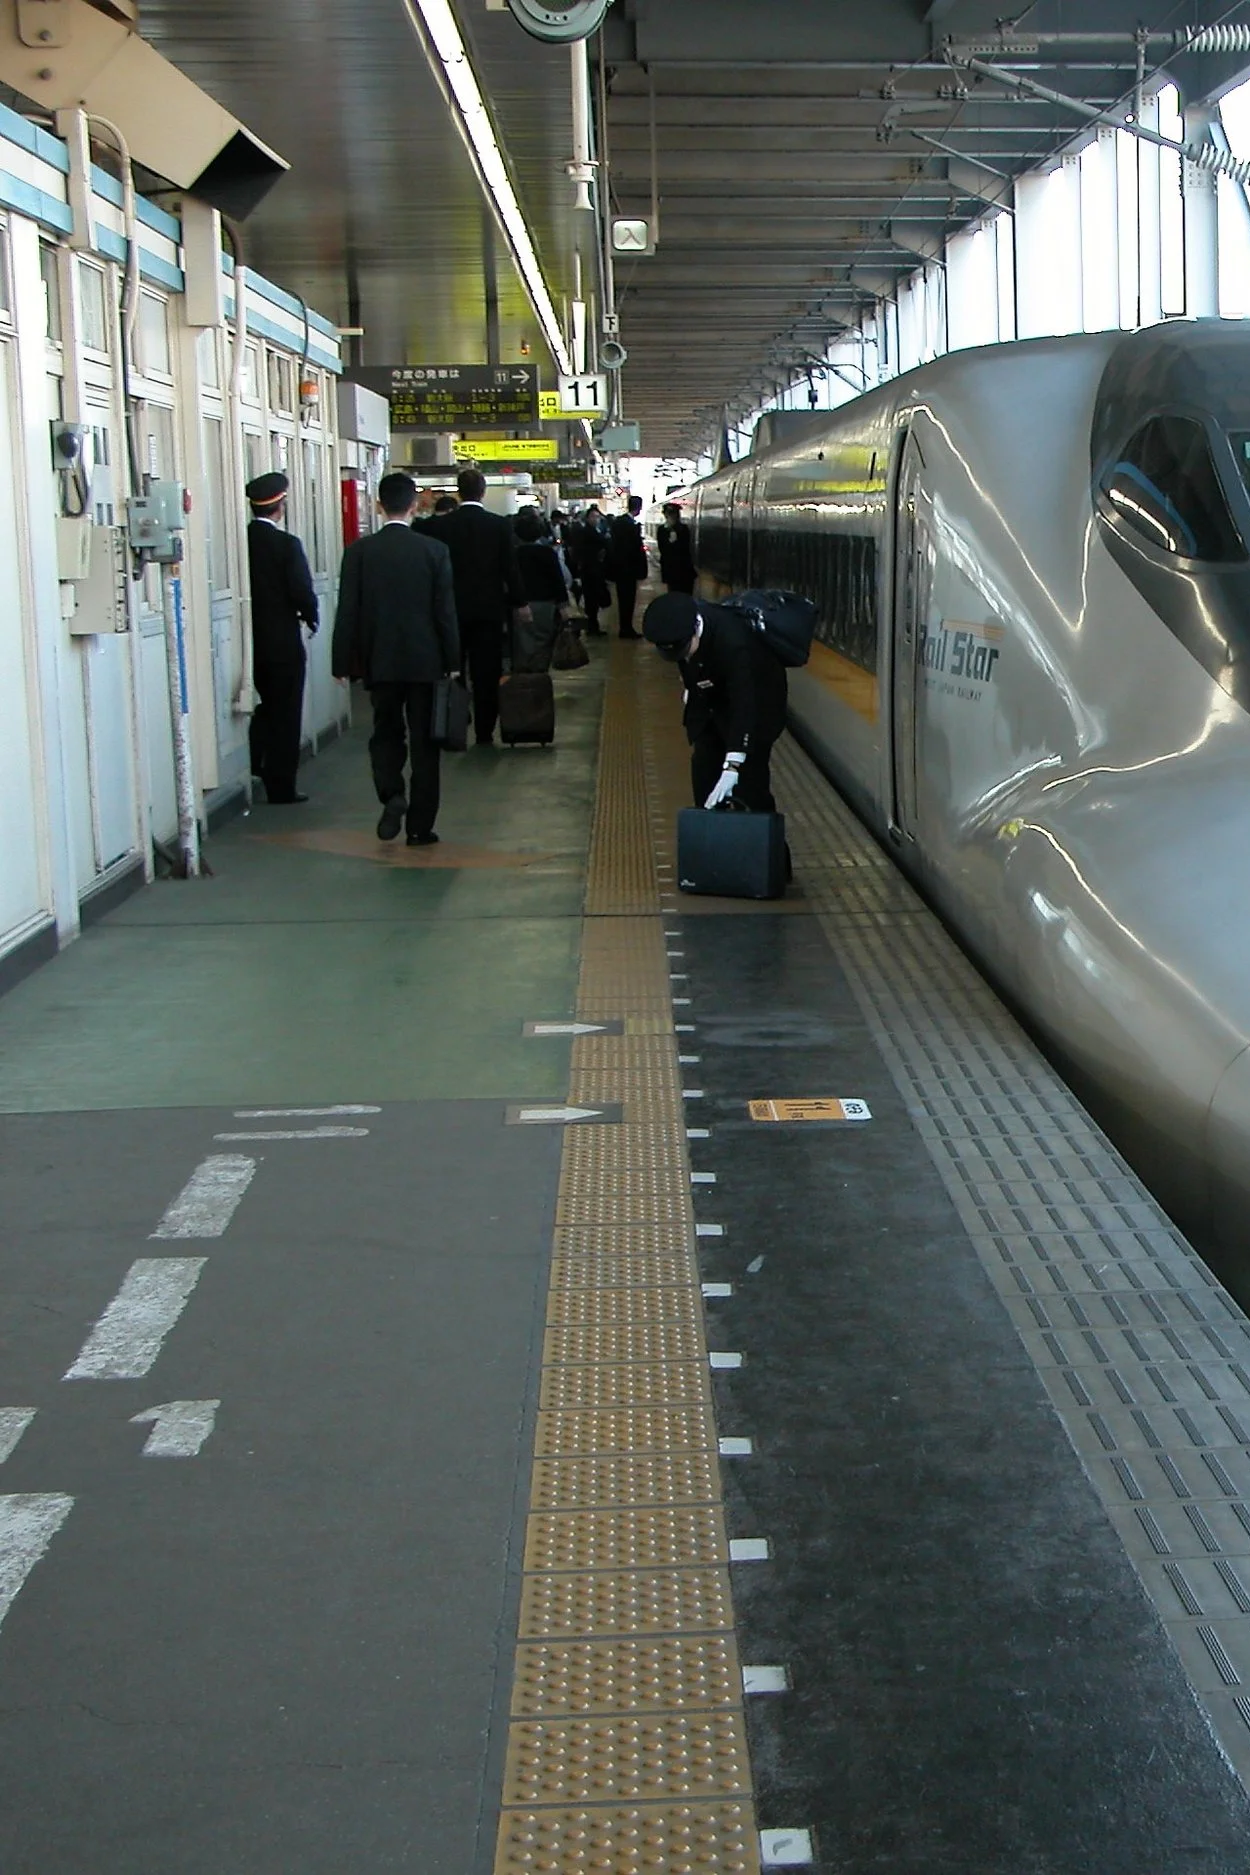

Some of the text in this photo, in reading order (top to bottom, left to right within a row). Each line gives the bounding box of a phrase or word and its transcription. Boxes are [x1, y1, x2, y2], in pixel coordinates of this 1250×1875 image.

[605, 316, 616, 331] 下
[496, 373, 506, 382] 11
[567, 380, 599, 406] 11
[600, 464, 612, 475] 11
[950, 631, 1000, 682] Star
